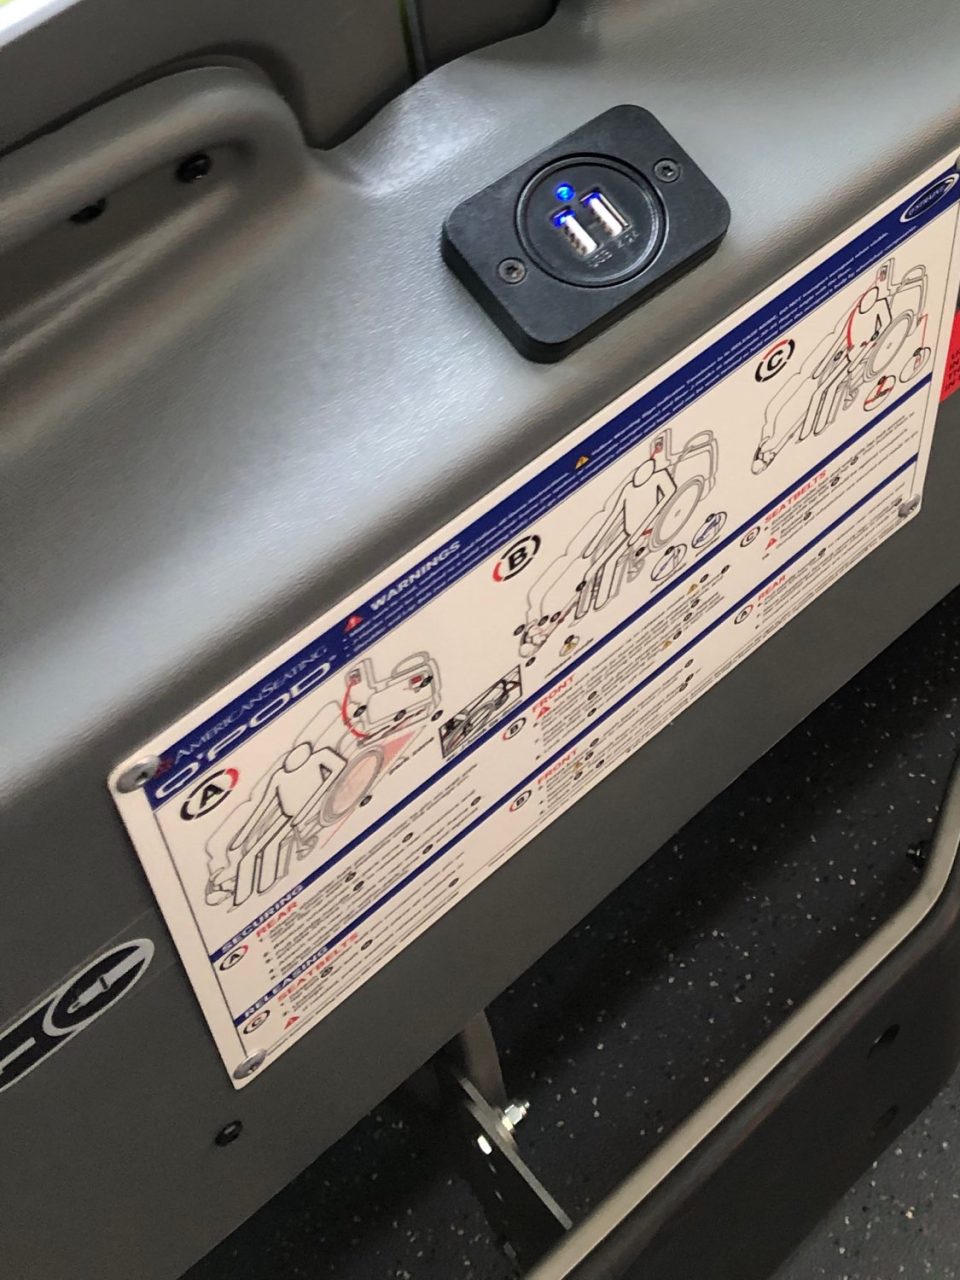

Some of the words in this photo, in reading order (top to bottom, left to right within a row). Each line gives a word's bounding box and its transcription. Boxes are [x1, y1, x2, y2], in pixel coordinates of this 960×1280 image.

[766, 350, 782, 371] C
[764, 467, 826, 525] SEATBELTS
[370, 538, 460, 613] WARNINGS
[507, 546, 528, 571] B
[532, 674, 573, 713] FRONT
[537, 747, 577, 786] FRONT
[199, 784, 224, 809] A
[220, 882, 304, 954] SECURING
[255, 899, 297, 938] REAR
[243, 944, 328, 1019] RELEASING
[277, 931, 358, 1003] SEATBELTS
